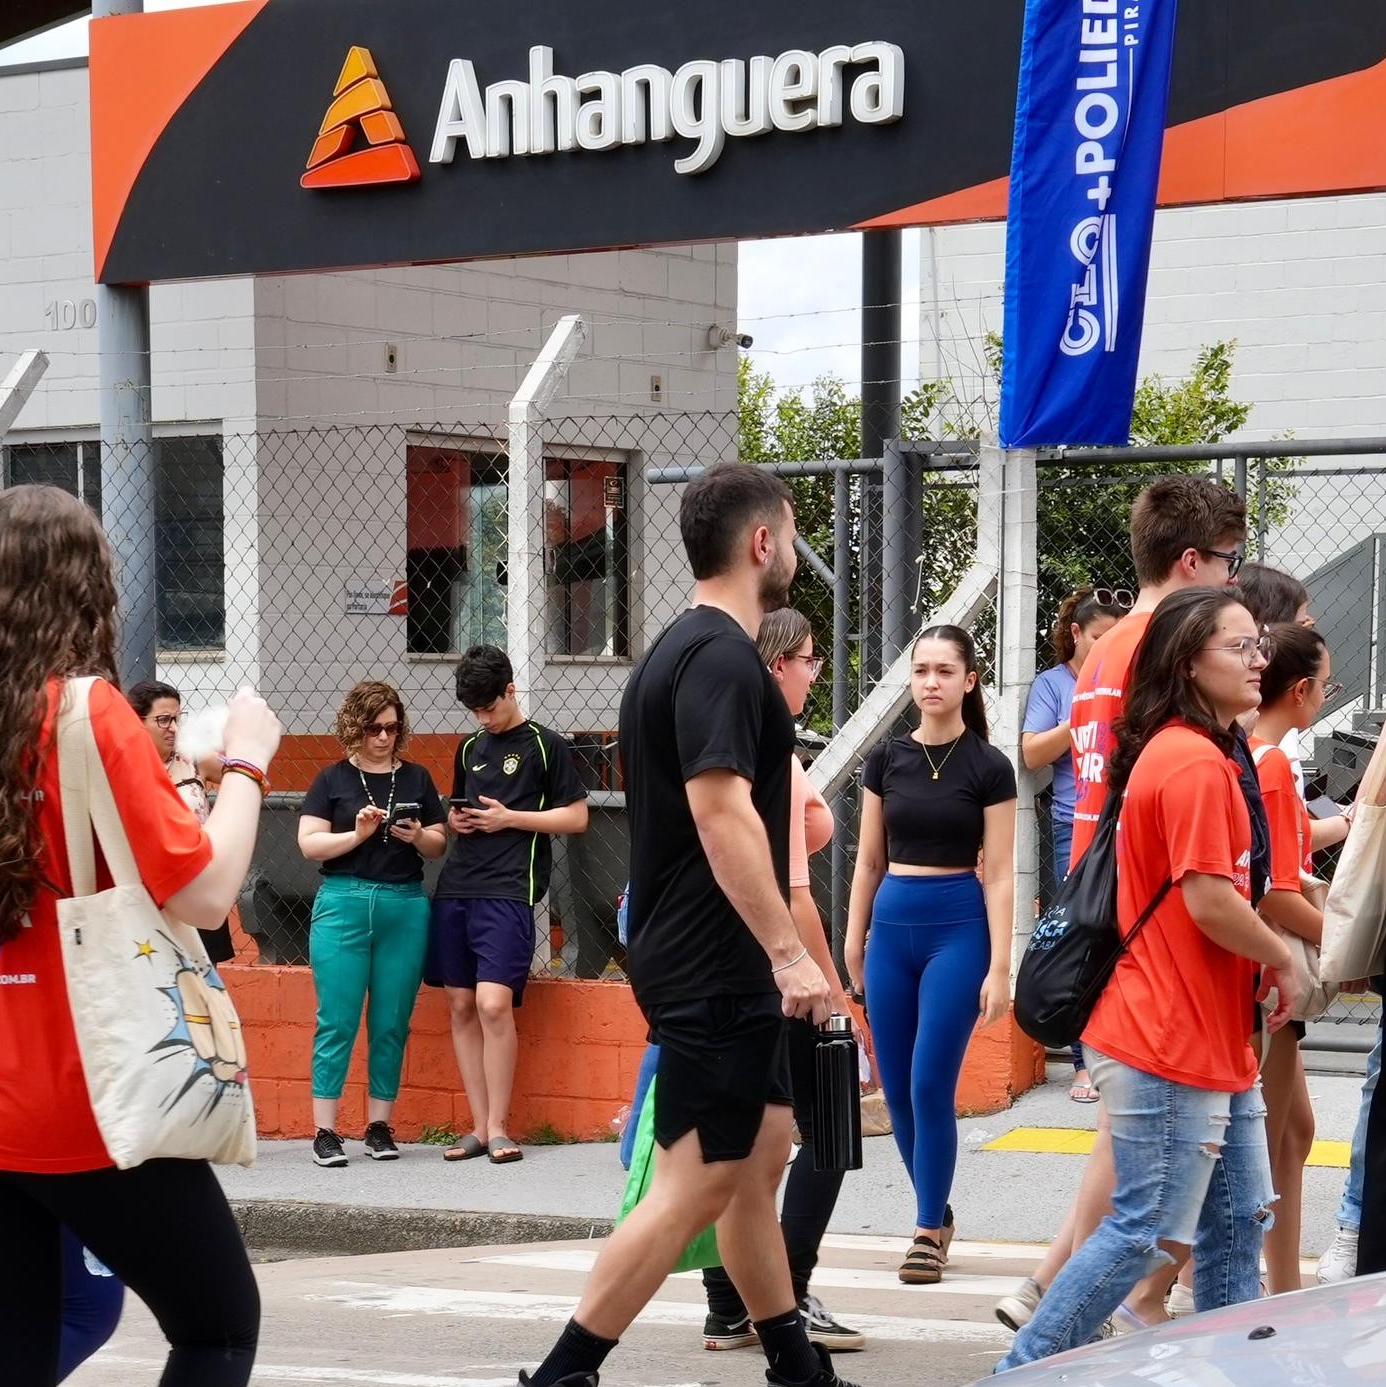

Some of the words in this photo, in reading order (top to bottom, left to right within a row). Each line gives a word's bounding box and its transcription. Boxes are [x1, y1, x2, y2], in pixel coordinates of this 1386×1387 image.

[1124, 0, 1139, 46] PIR
[429, 40, 905, 175] Anhanguera
[45, 299, 97, 331] 100
